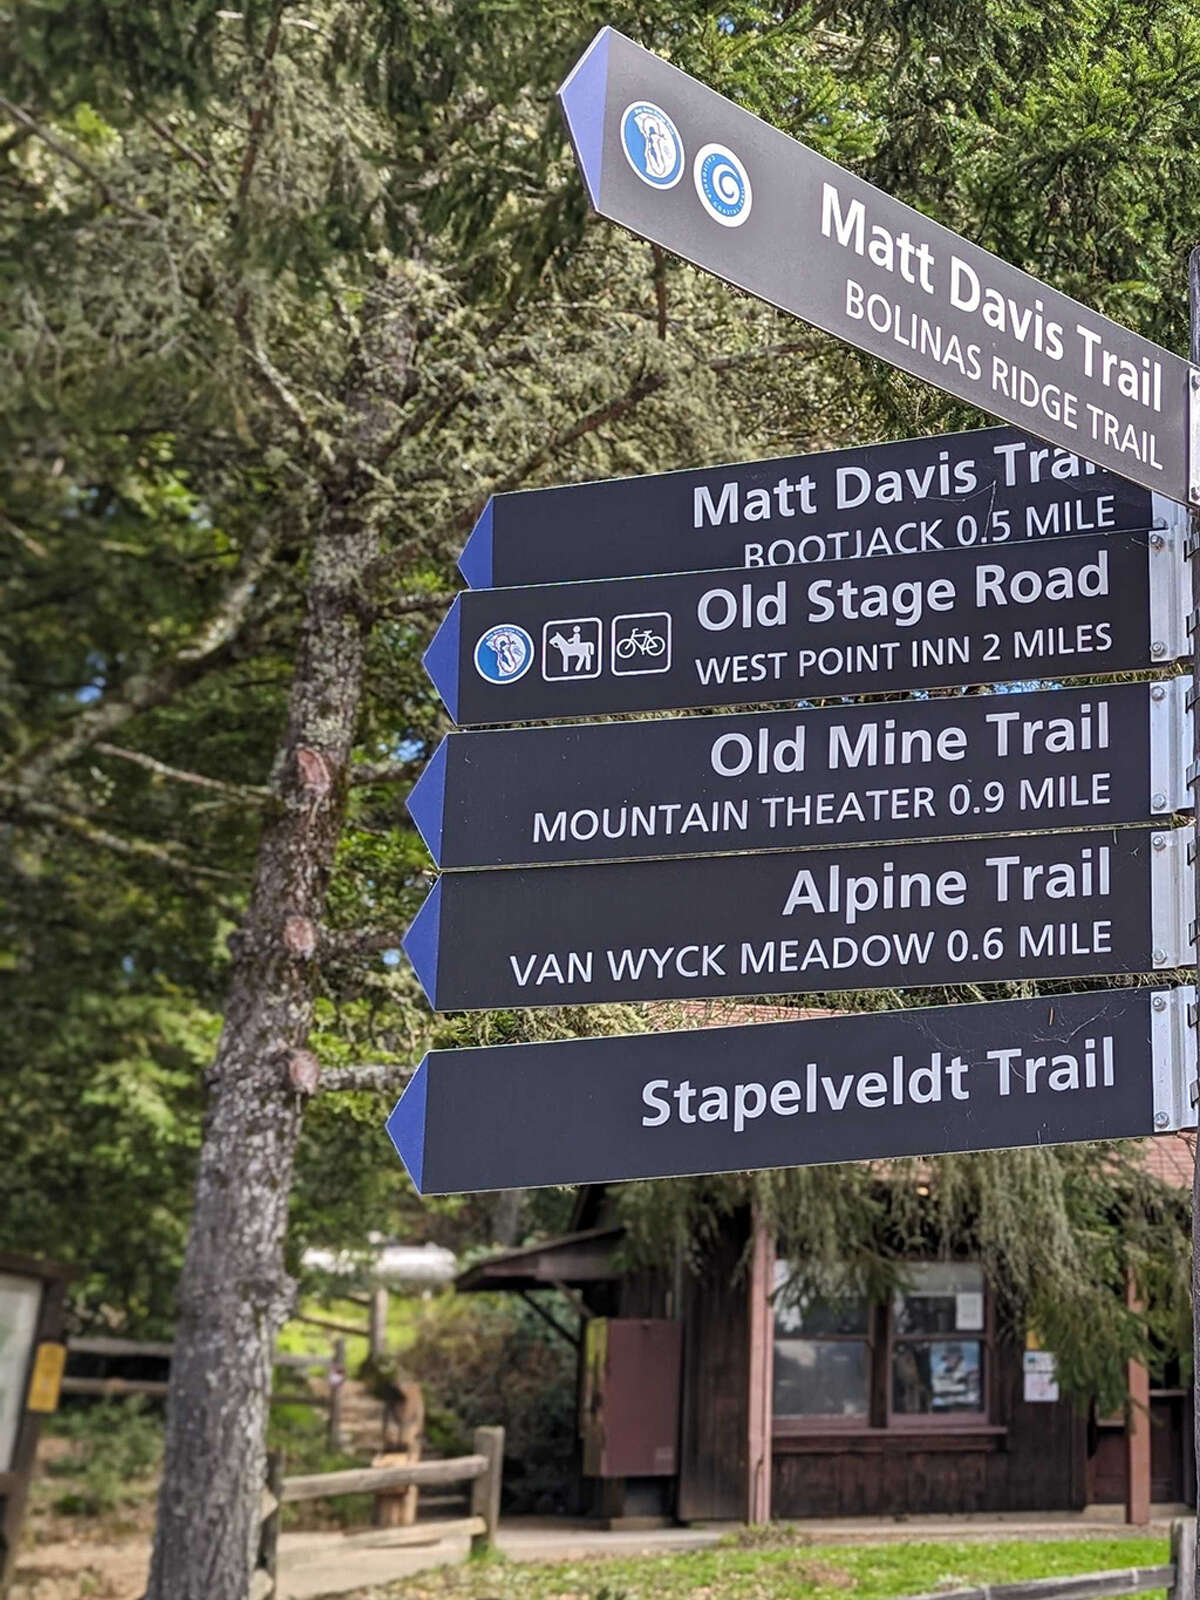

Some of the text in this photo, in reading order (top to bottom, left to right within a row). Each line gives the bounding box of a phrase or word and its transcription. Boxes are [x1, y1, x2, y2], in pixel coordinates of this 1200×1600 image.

[822, 183, 1161, 411] Matt Davis Trail
[846, 279, 1162, 469] BOLINAS RIDGE TRAIL
[695, 442, 1107, 527] Matt Davis Tra
[743, 496, 1115, 568] BOOTJACK 0.5 MILE
[698, 550, 1108, 630] Old Stage Road
[695, 623, 1111, 684] WEST POINT INN 2 MILES
[711, 702, 1108, 776] Old Mine Trail
[534, 773, 1110, 842] MOUNTAIN THEATER 0.9 MILE
[783, 847, 1109, 923] Alpine Trail
[510, 921, 1111, 985] VAN WYCK MEADOW 0.6 MILE
[643, 1037, 1113, 1129] Stapelveldt Trail
